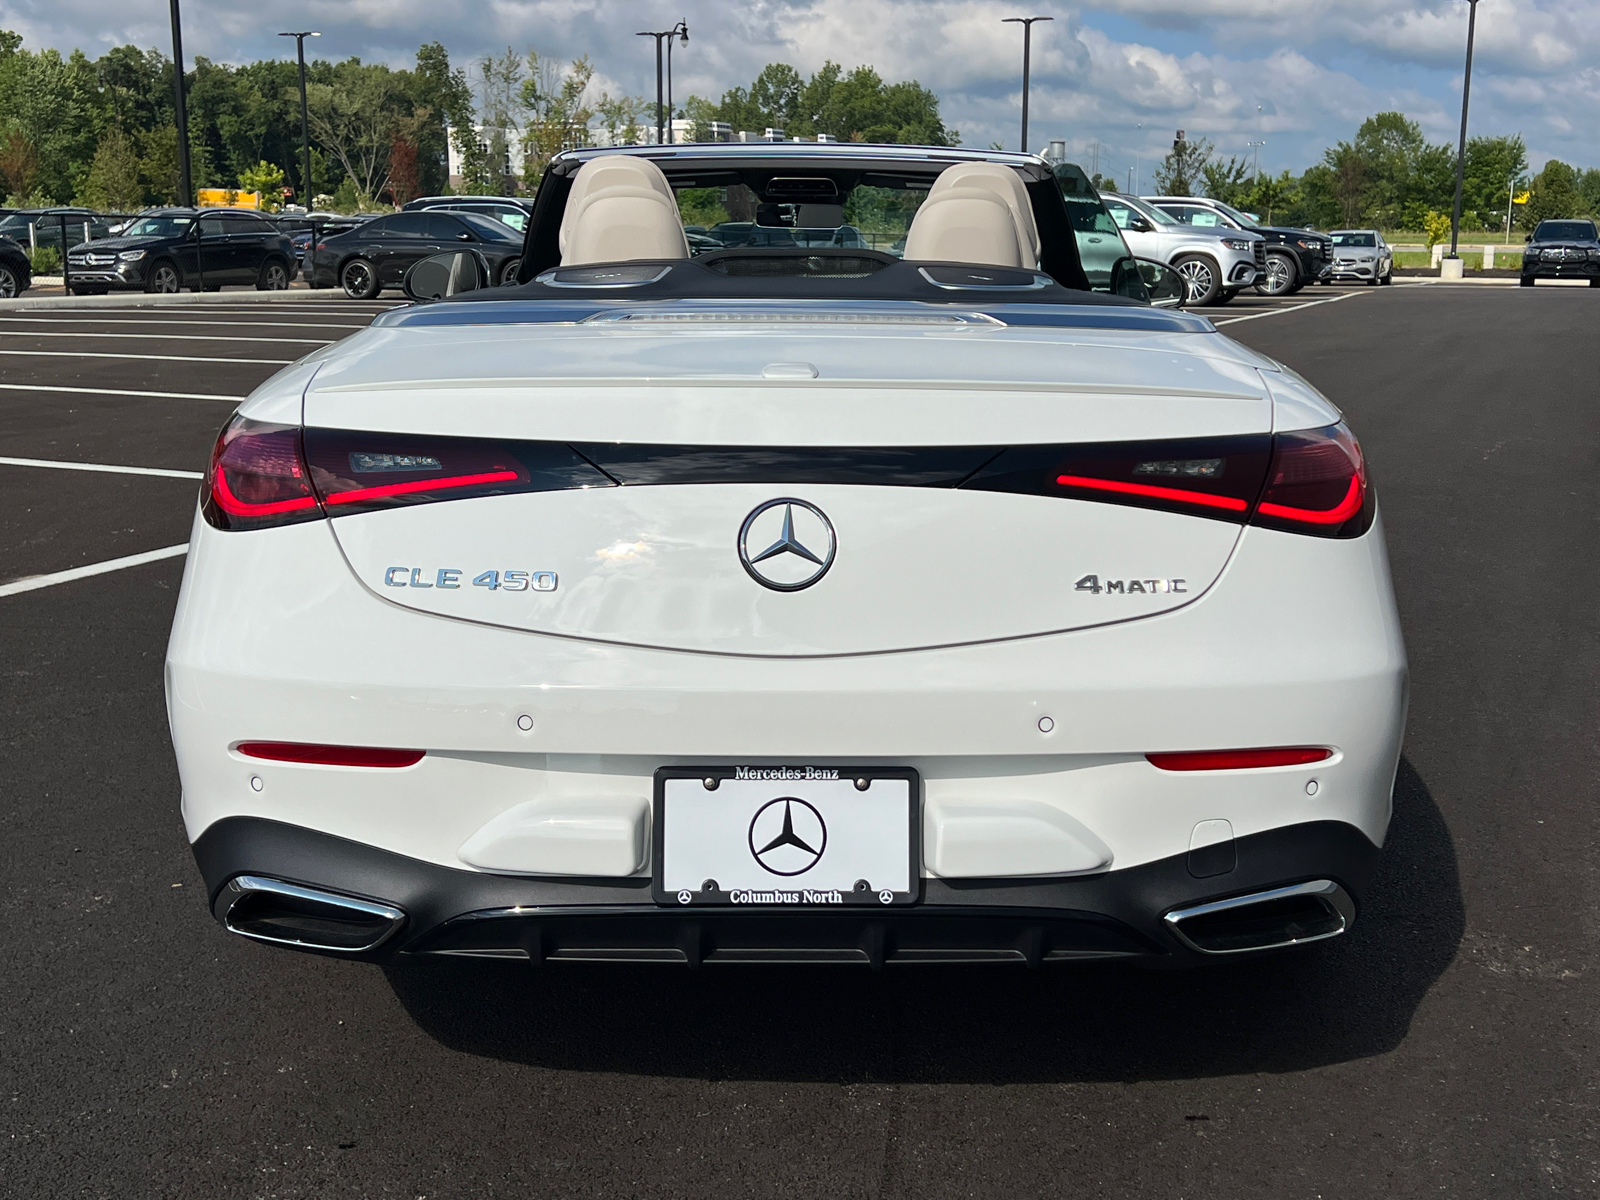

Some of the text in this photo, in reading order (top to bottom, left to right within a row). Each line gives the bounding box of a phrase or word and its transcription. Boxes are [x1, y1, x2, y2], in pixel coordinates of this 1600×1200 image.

[384, 566, 559, 592] CLE 450
[1074, 574, 1188, 594] 4MATIC
[735, 766, 839, 780] Mercedes-Benz
[729, 889, 843, 904] Columbus North
